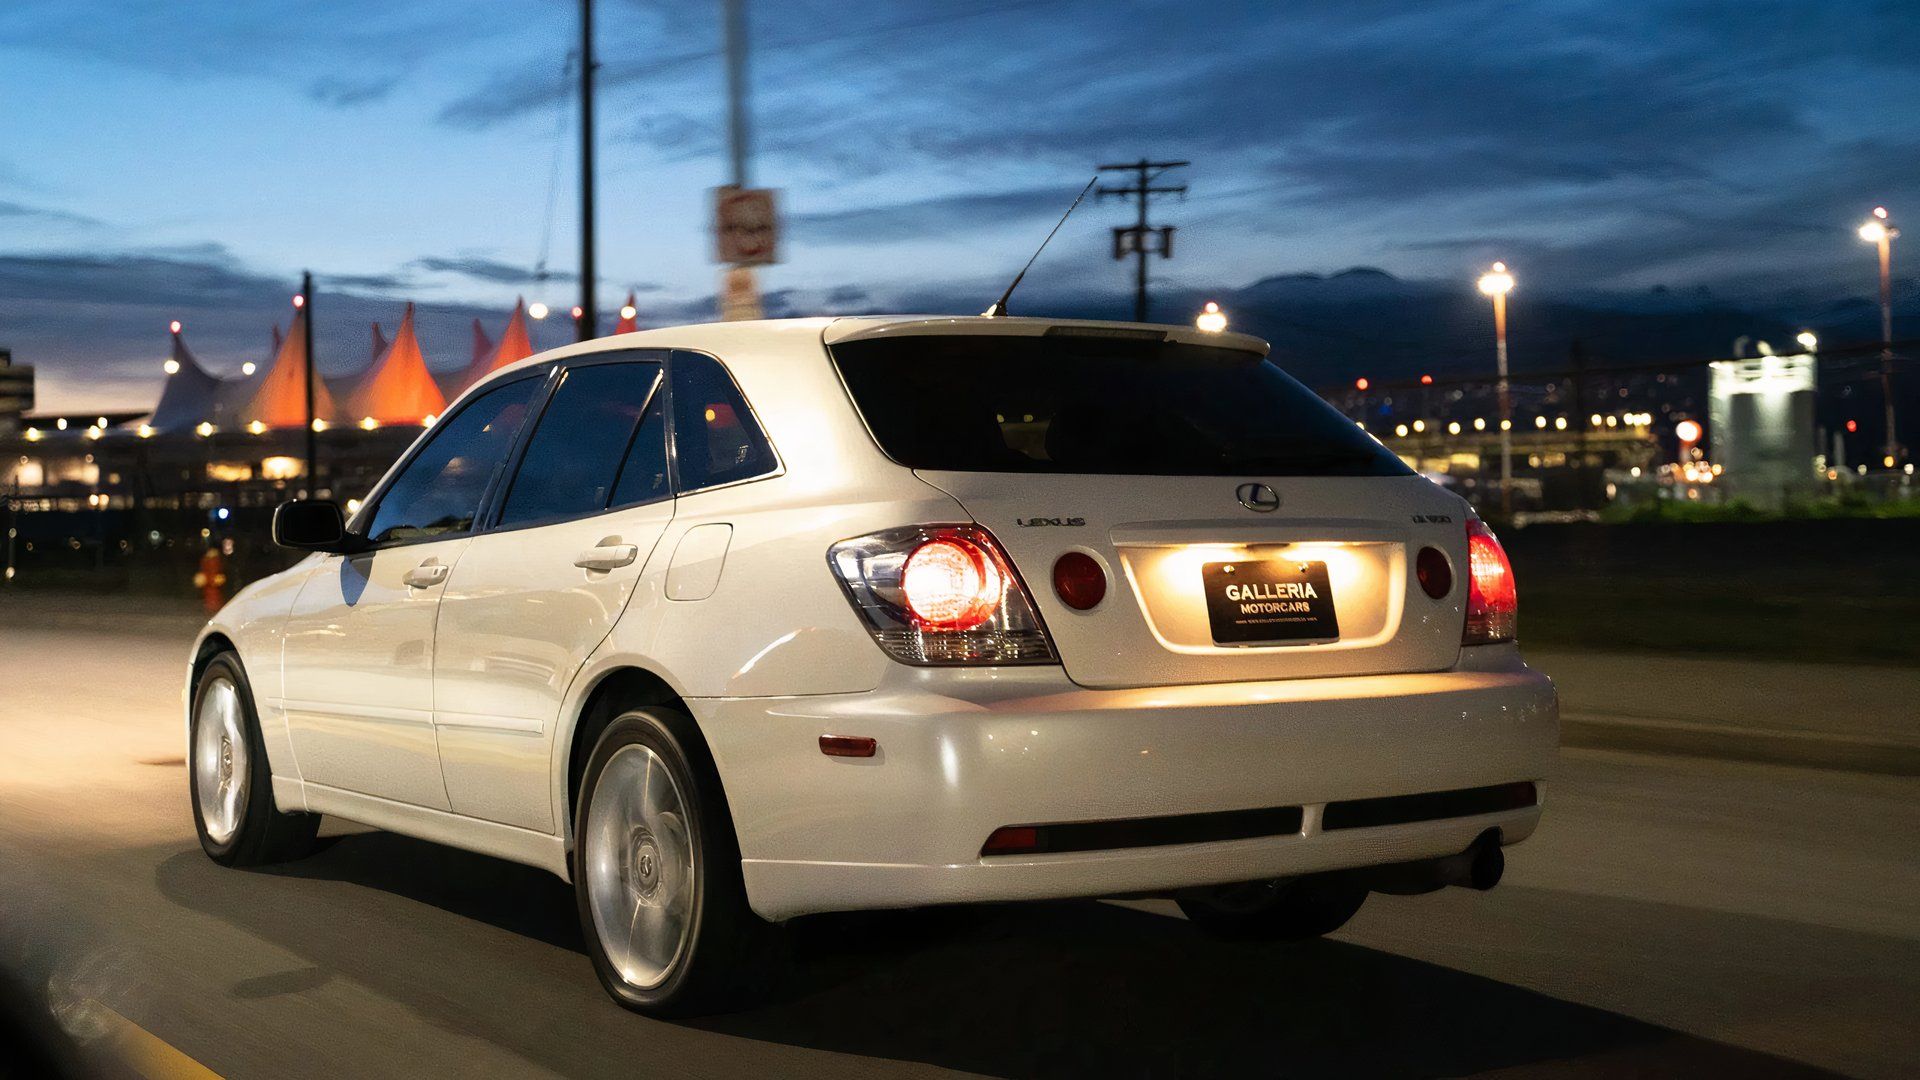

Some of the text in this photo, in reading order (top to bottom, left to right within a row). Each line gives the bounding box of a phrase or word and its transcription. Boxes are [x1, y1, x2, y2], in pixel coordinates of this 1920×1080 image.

[1017, 517, 1086, 527] LEXUS
[1225, 583, 1318, 601] GALLERIA
[1240, 602, 1310, 615] MOTORCARS
